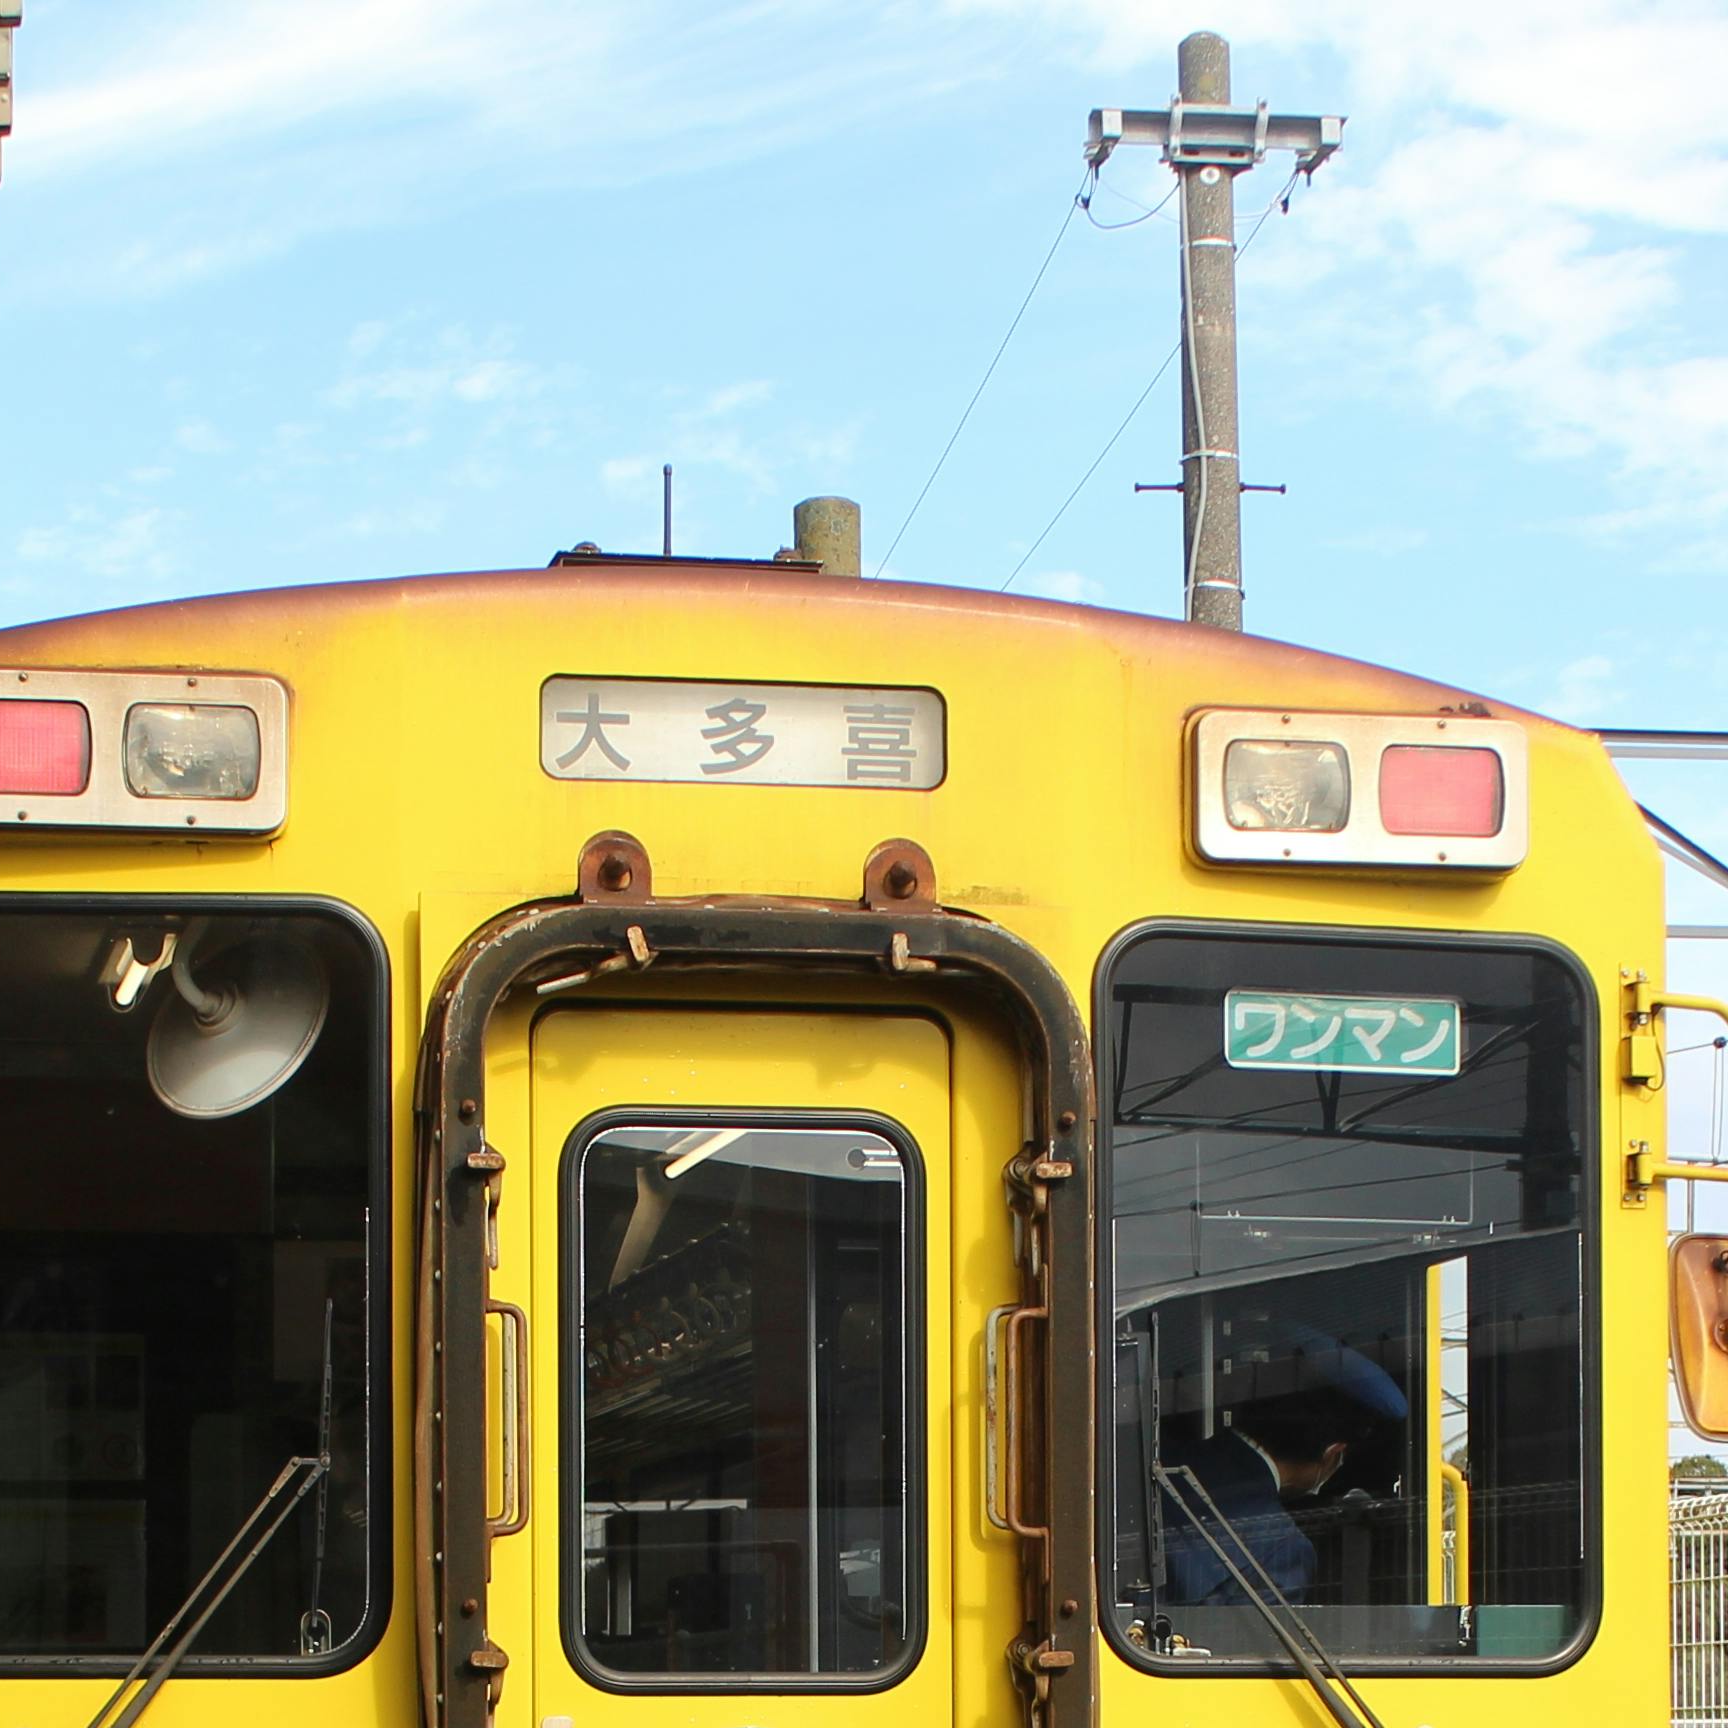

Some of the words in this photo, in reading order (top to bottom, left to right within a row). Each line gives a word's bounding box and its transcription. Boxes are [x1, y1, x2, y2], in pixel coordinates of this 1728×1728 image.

[555, 692, 918, 783] 大多喜
[1234, 1002, 1450, 1063] ワンマン
